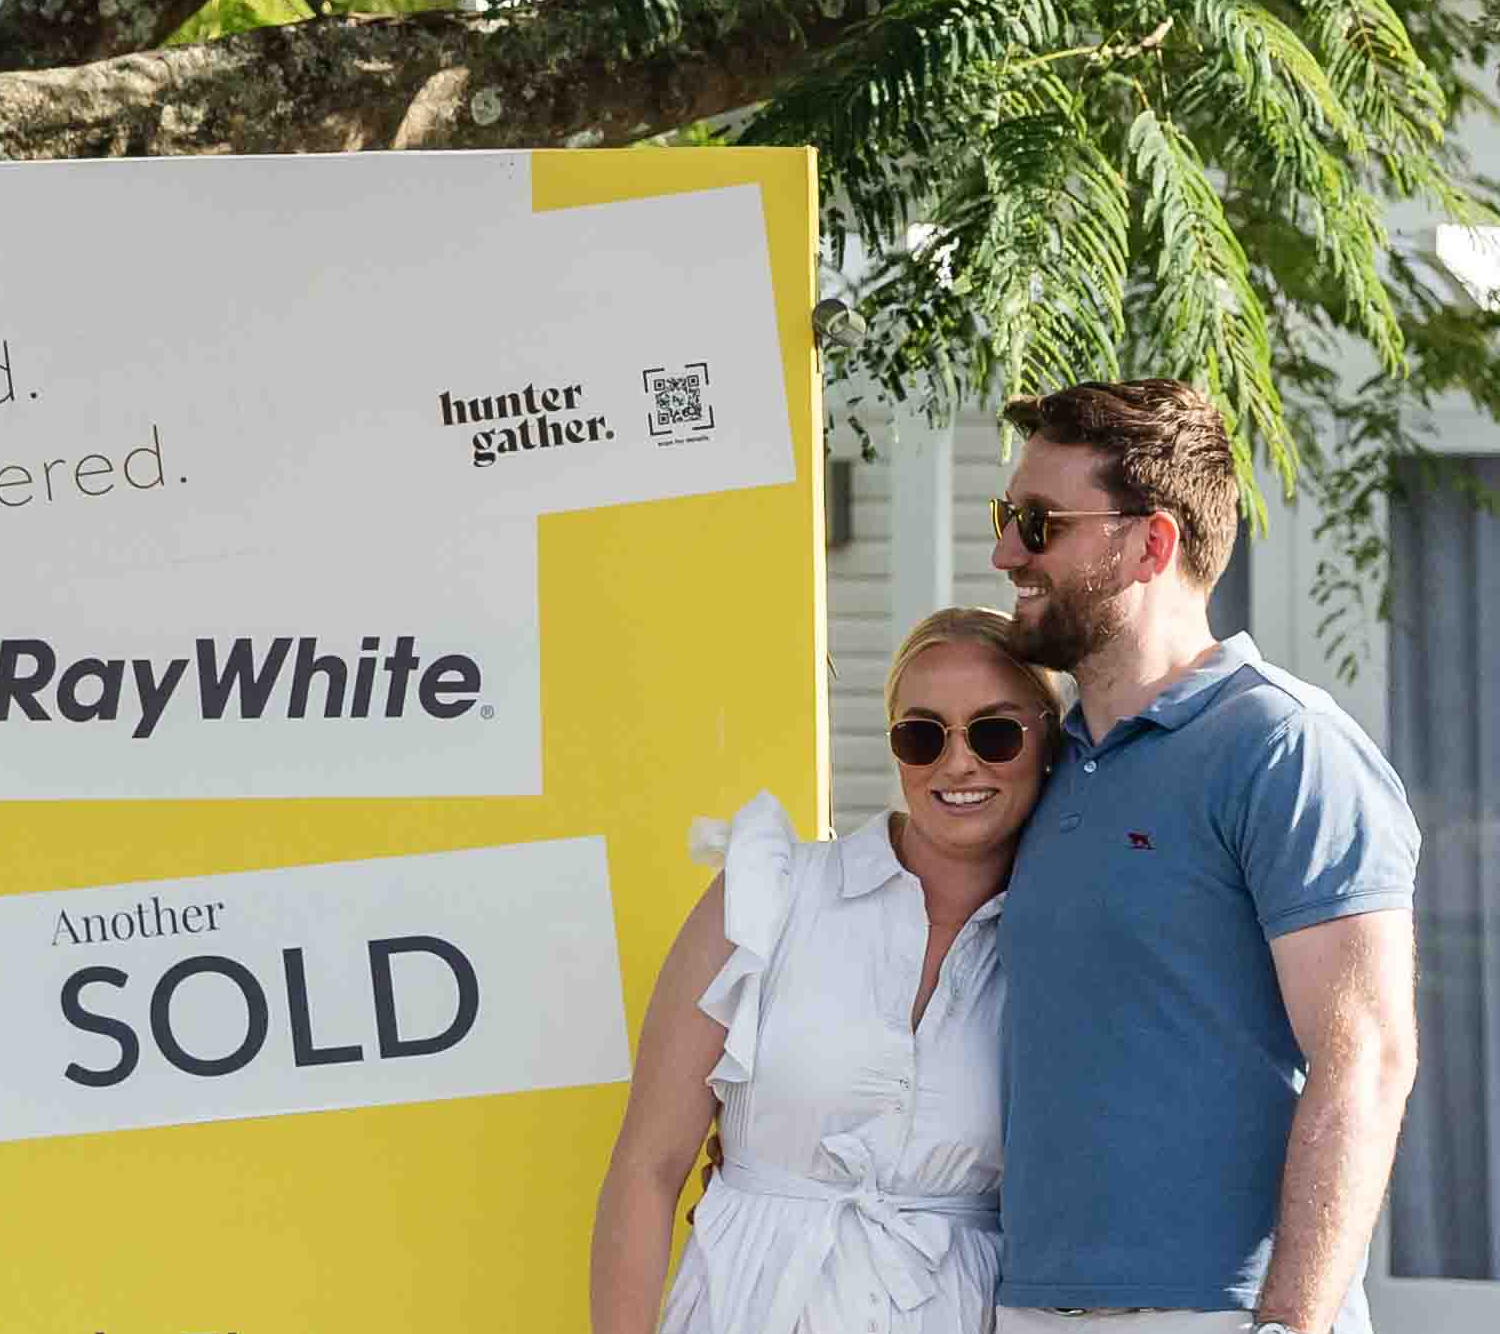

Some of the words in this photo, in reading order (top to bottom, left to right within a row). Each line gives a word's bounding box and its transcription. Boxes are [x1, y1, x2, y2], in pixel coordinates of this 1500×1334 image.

[438, 382, 583, 427] hunter
[471, 413, 615, 469] gather.
[50, 894, 227, 948] Another
[58, 934, 480, 1089] SOLD
